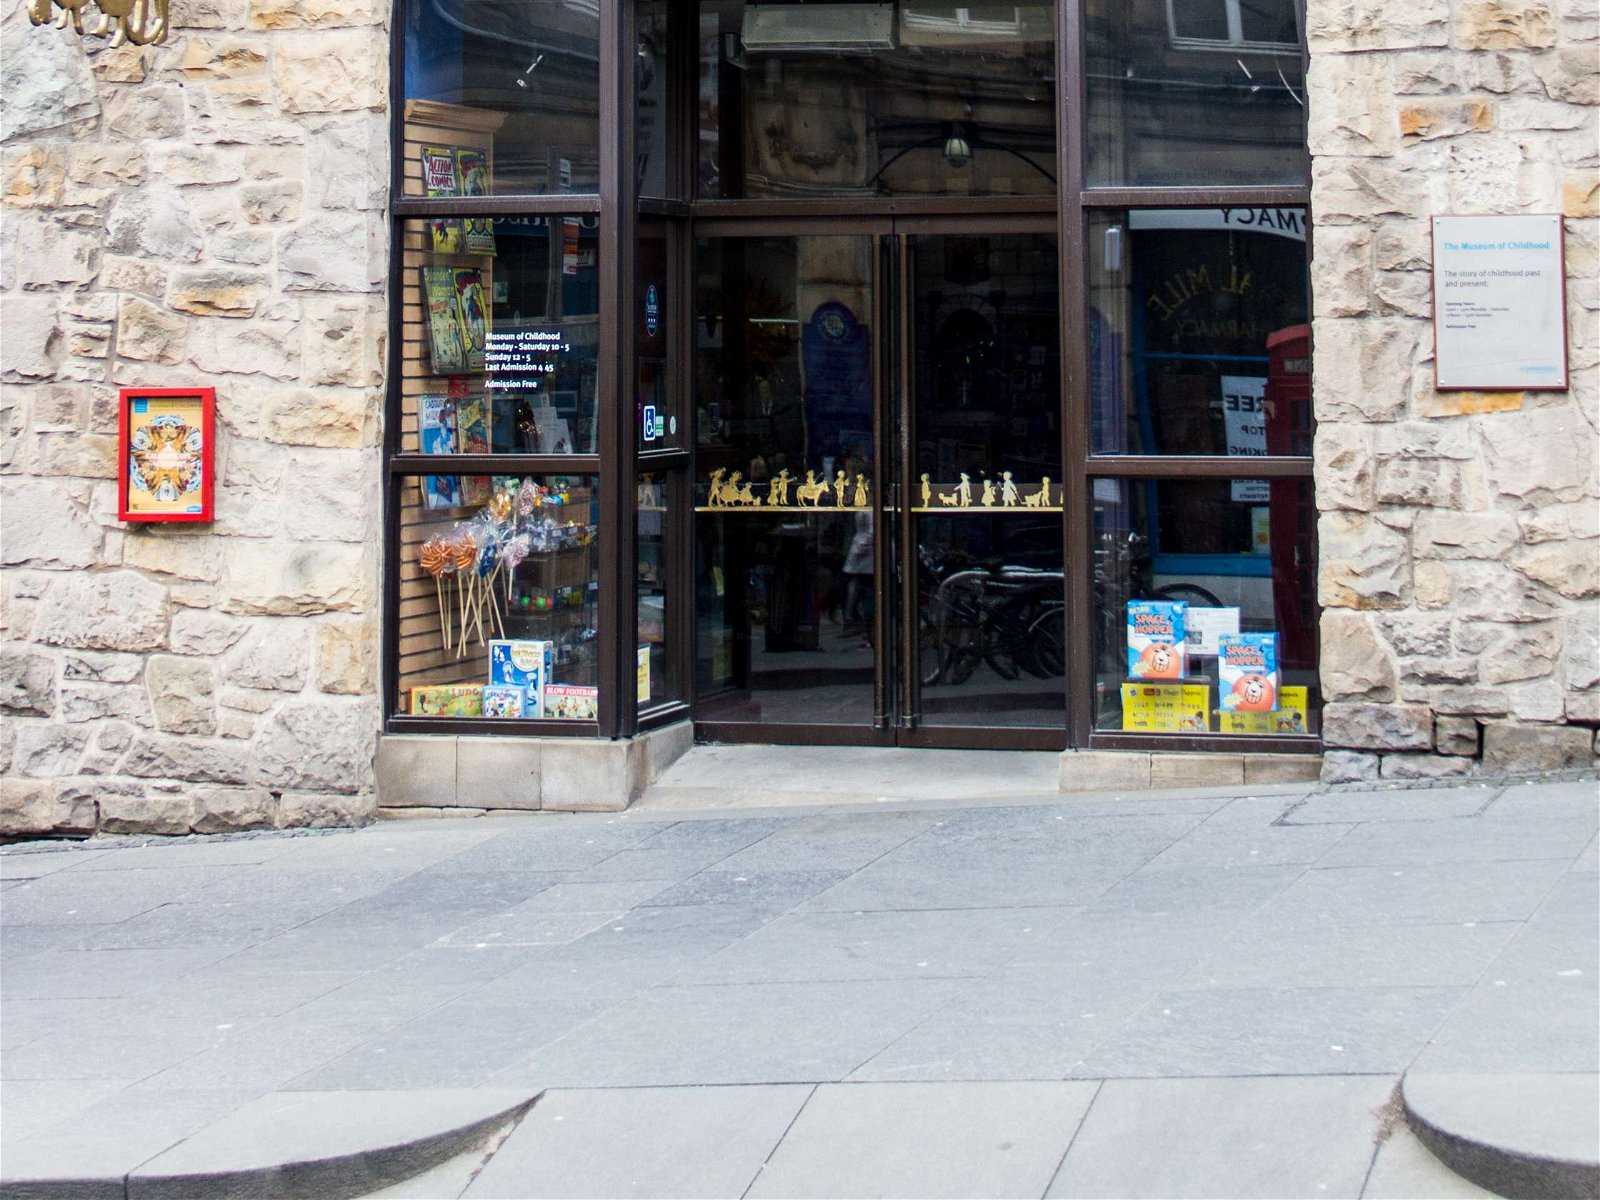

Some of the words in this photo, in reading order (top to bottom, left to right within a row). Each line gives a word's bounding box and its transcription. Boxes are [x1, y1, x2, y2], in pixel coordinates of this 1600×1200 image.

[429, 154, 452, 174] ACTION
[1461, 242, 1495, 250] Museum
[1497, 242, 1505, 250] of
[1507, 241, 1549, 250] Childhood
[1444, 270, 1458, 278] The
[1460, 270, 1477, 279] story
[1487, 269, 1523, 277] childhood
[1524, 270, 1541, 278] past
[1444, 280, 1458, 288] and
[485, 332, 515, 340] Museum
[516, 332, 524, 340] of
[524, 332, 560, 340] Childhood
[485, 342, 514, 352] Monday
[518, 342, 550, 352] Saturday
[564, 344, 570, 352] 5
[485, 353, 511, 362] Sunday
[526, 354, 531, 362] 5
[485, 363, 500, 371] Last
[501, 363, 537, 371] Admission
[484, 380, 521, 388] Admission
[522, 380, 537, 388] Free
[1135, 614, 1167, 623] SPACE
[1226, 645, 1257, 654] SPACE
[546, 687, 565, 695] BLOW
